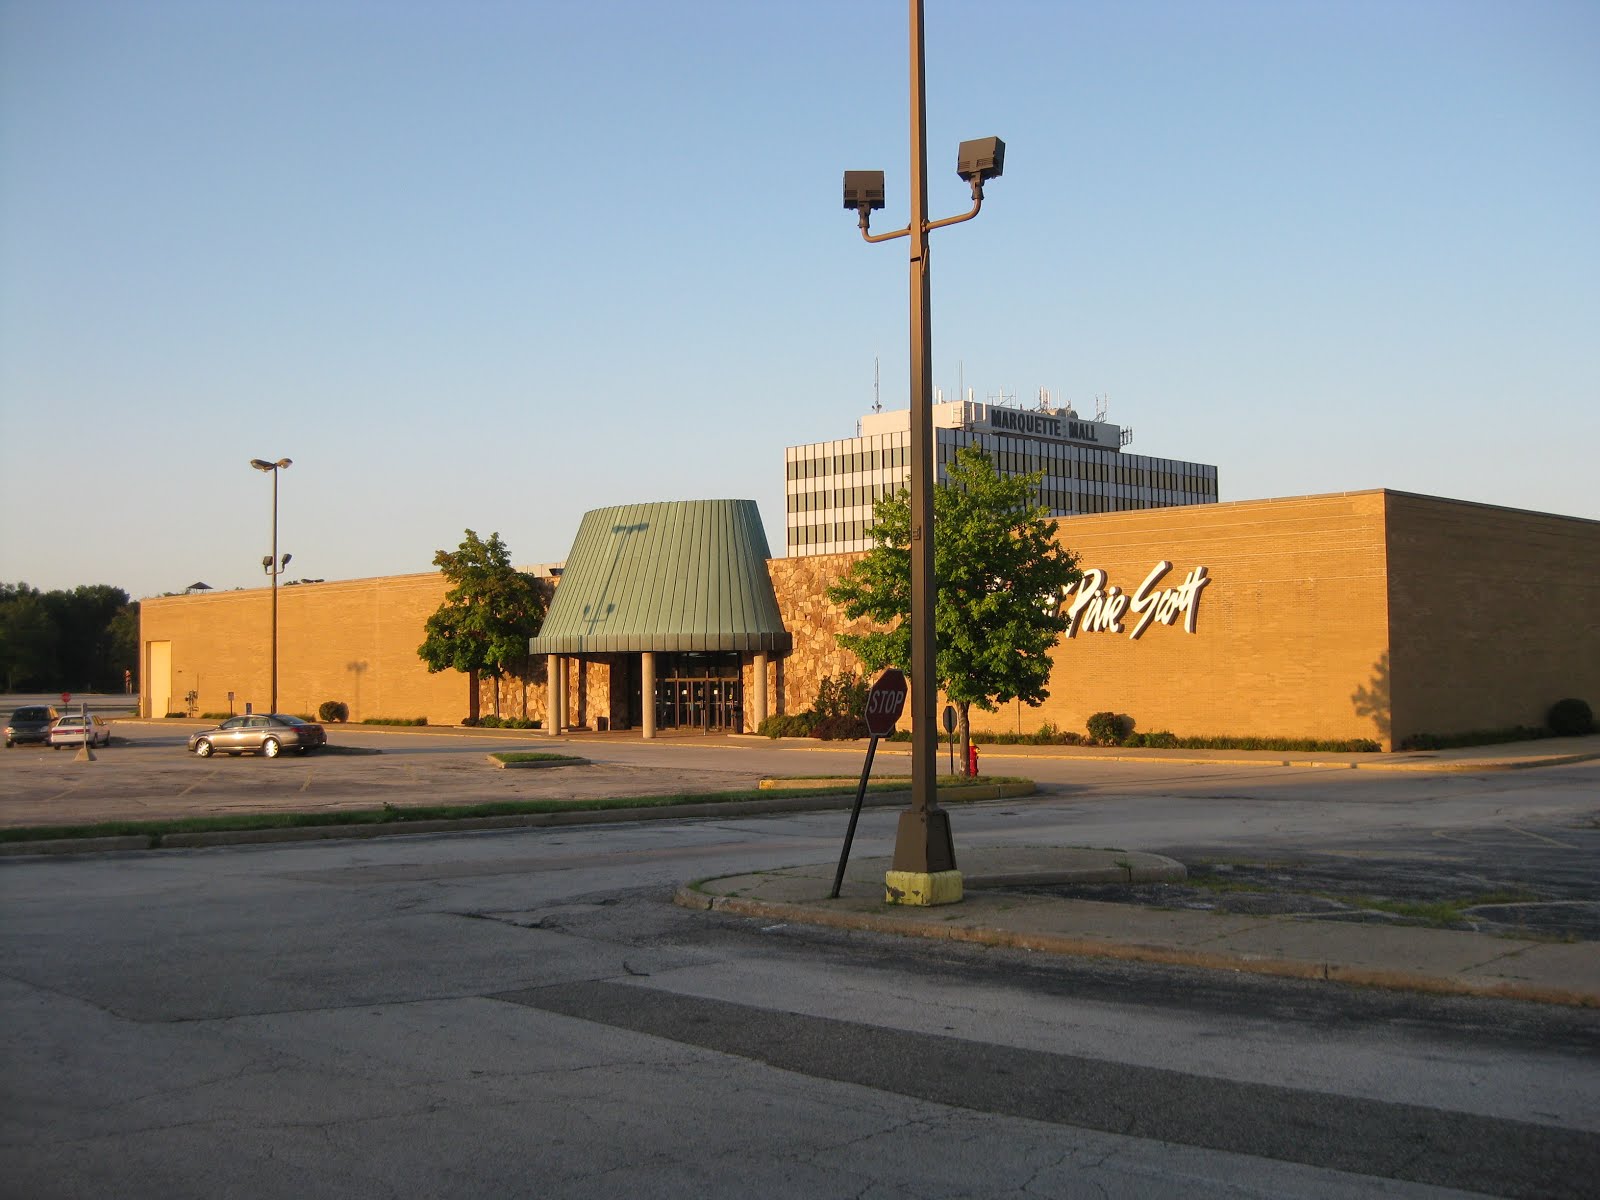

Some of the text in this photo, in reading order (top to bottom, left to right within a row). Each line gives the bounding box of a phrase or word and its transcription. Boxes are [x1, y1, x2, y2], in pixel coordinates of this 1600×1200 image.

[991, 409, 1098, 442] MARQUETTE MALL
[1129, 560, 1211, 640] Scott
[869, 690, 904, 714] STOP
